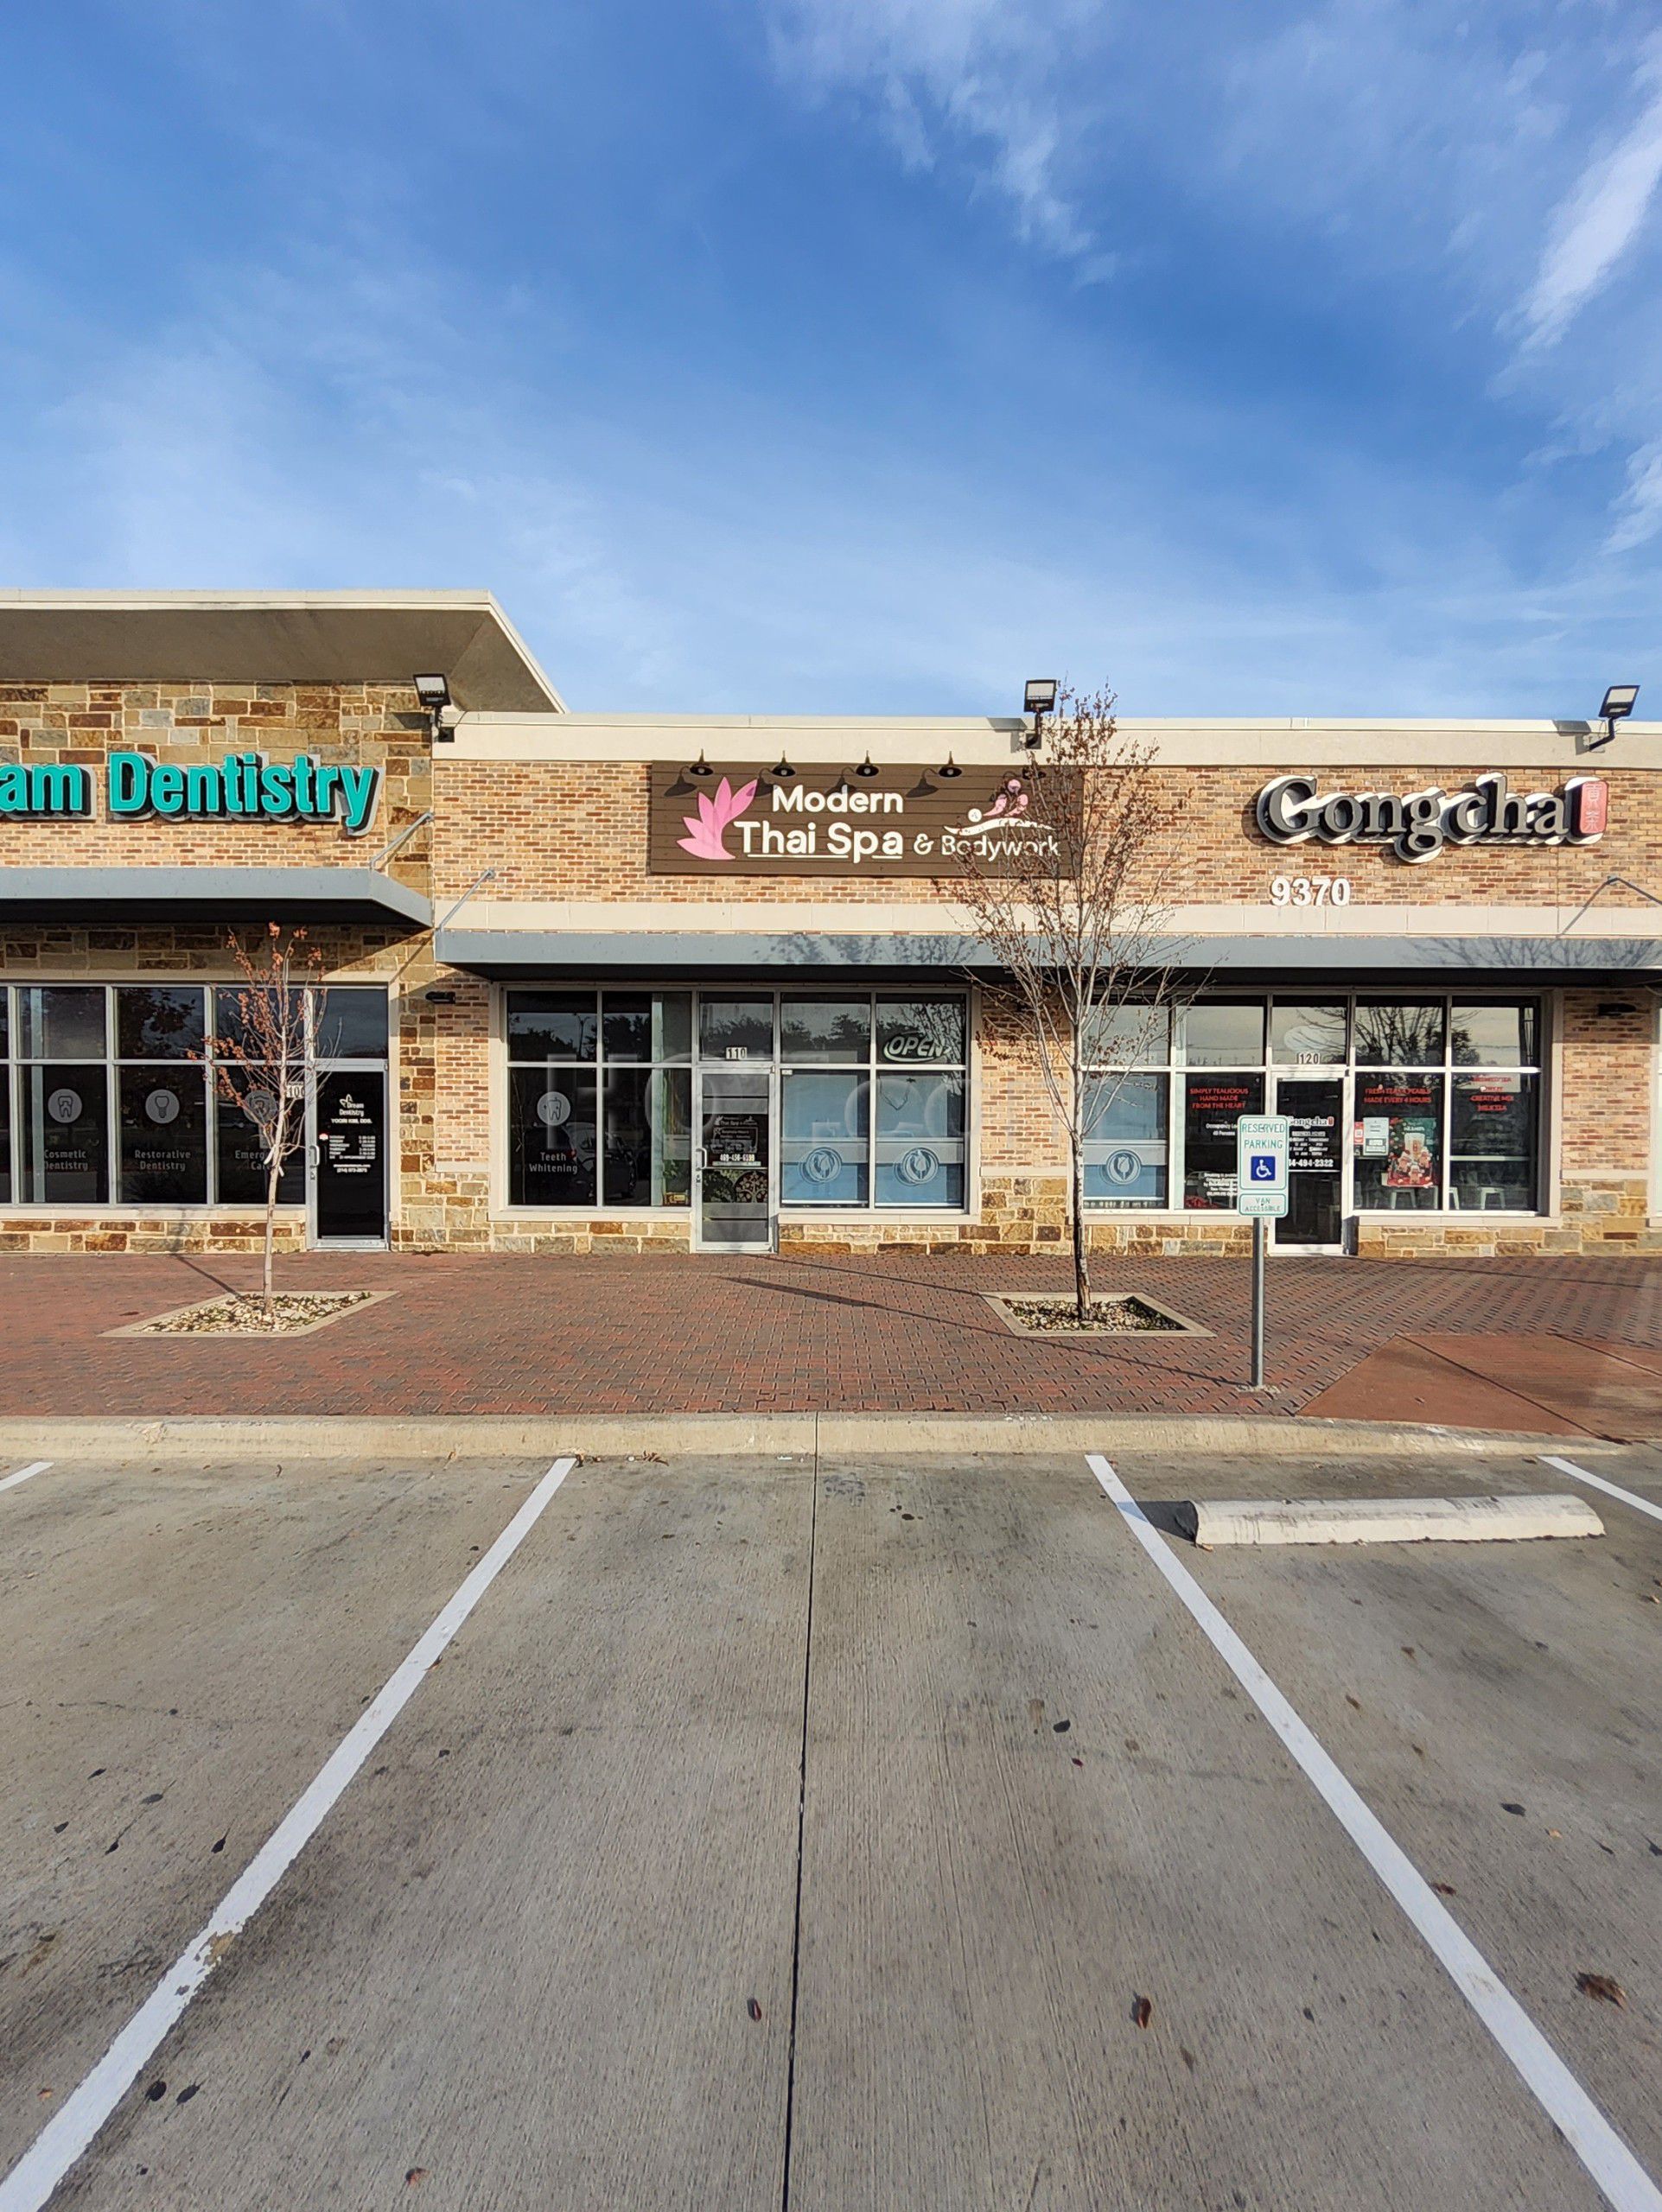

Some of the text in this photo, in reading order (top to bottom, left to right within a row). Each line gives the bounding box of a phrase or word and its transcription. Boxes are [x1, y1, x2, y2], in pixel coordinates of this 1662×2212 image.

[109, 751, 375, 829] Dentistry
[771, 784, 904, 814] Modern
[733, 820, 1061, 864] Thai Spa & Bodywork
[1270, 876, 1352, 906] 9370
[888, 1036, 944, 1057] OPEN
[728, 1047, 746, 1059] 110
[1299, 1053, 1319, 1065] 120
[339, 1109, 365, 1117] Dentistry
[1241, 1123, 1285, 1134] RESERVED
[1244, 1140, 1283, 1149] PARKING
[43, 1149, 86, 1159] Cosmetic
[134, 1149, 191, 1160] Restorative
[540, 1152, 567, 1161] Teeth
[140, 1160, 187, 1172] Dentistry
[529, 1164, 578, 1175] Whitening
